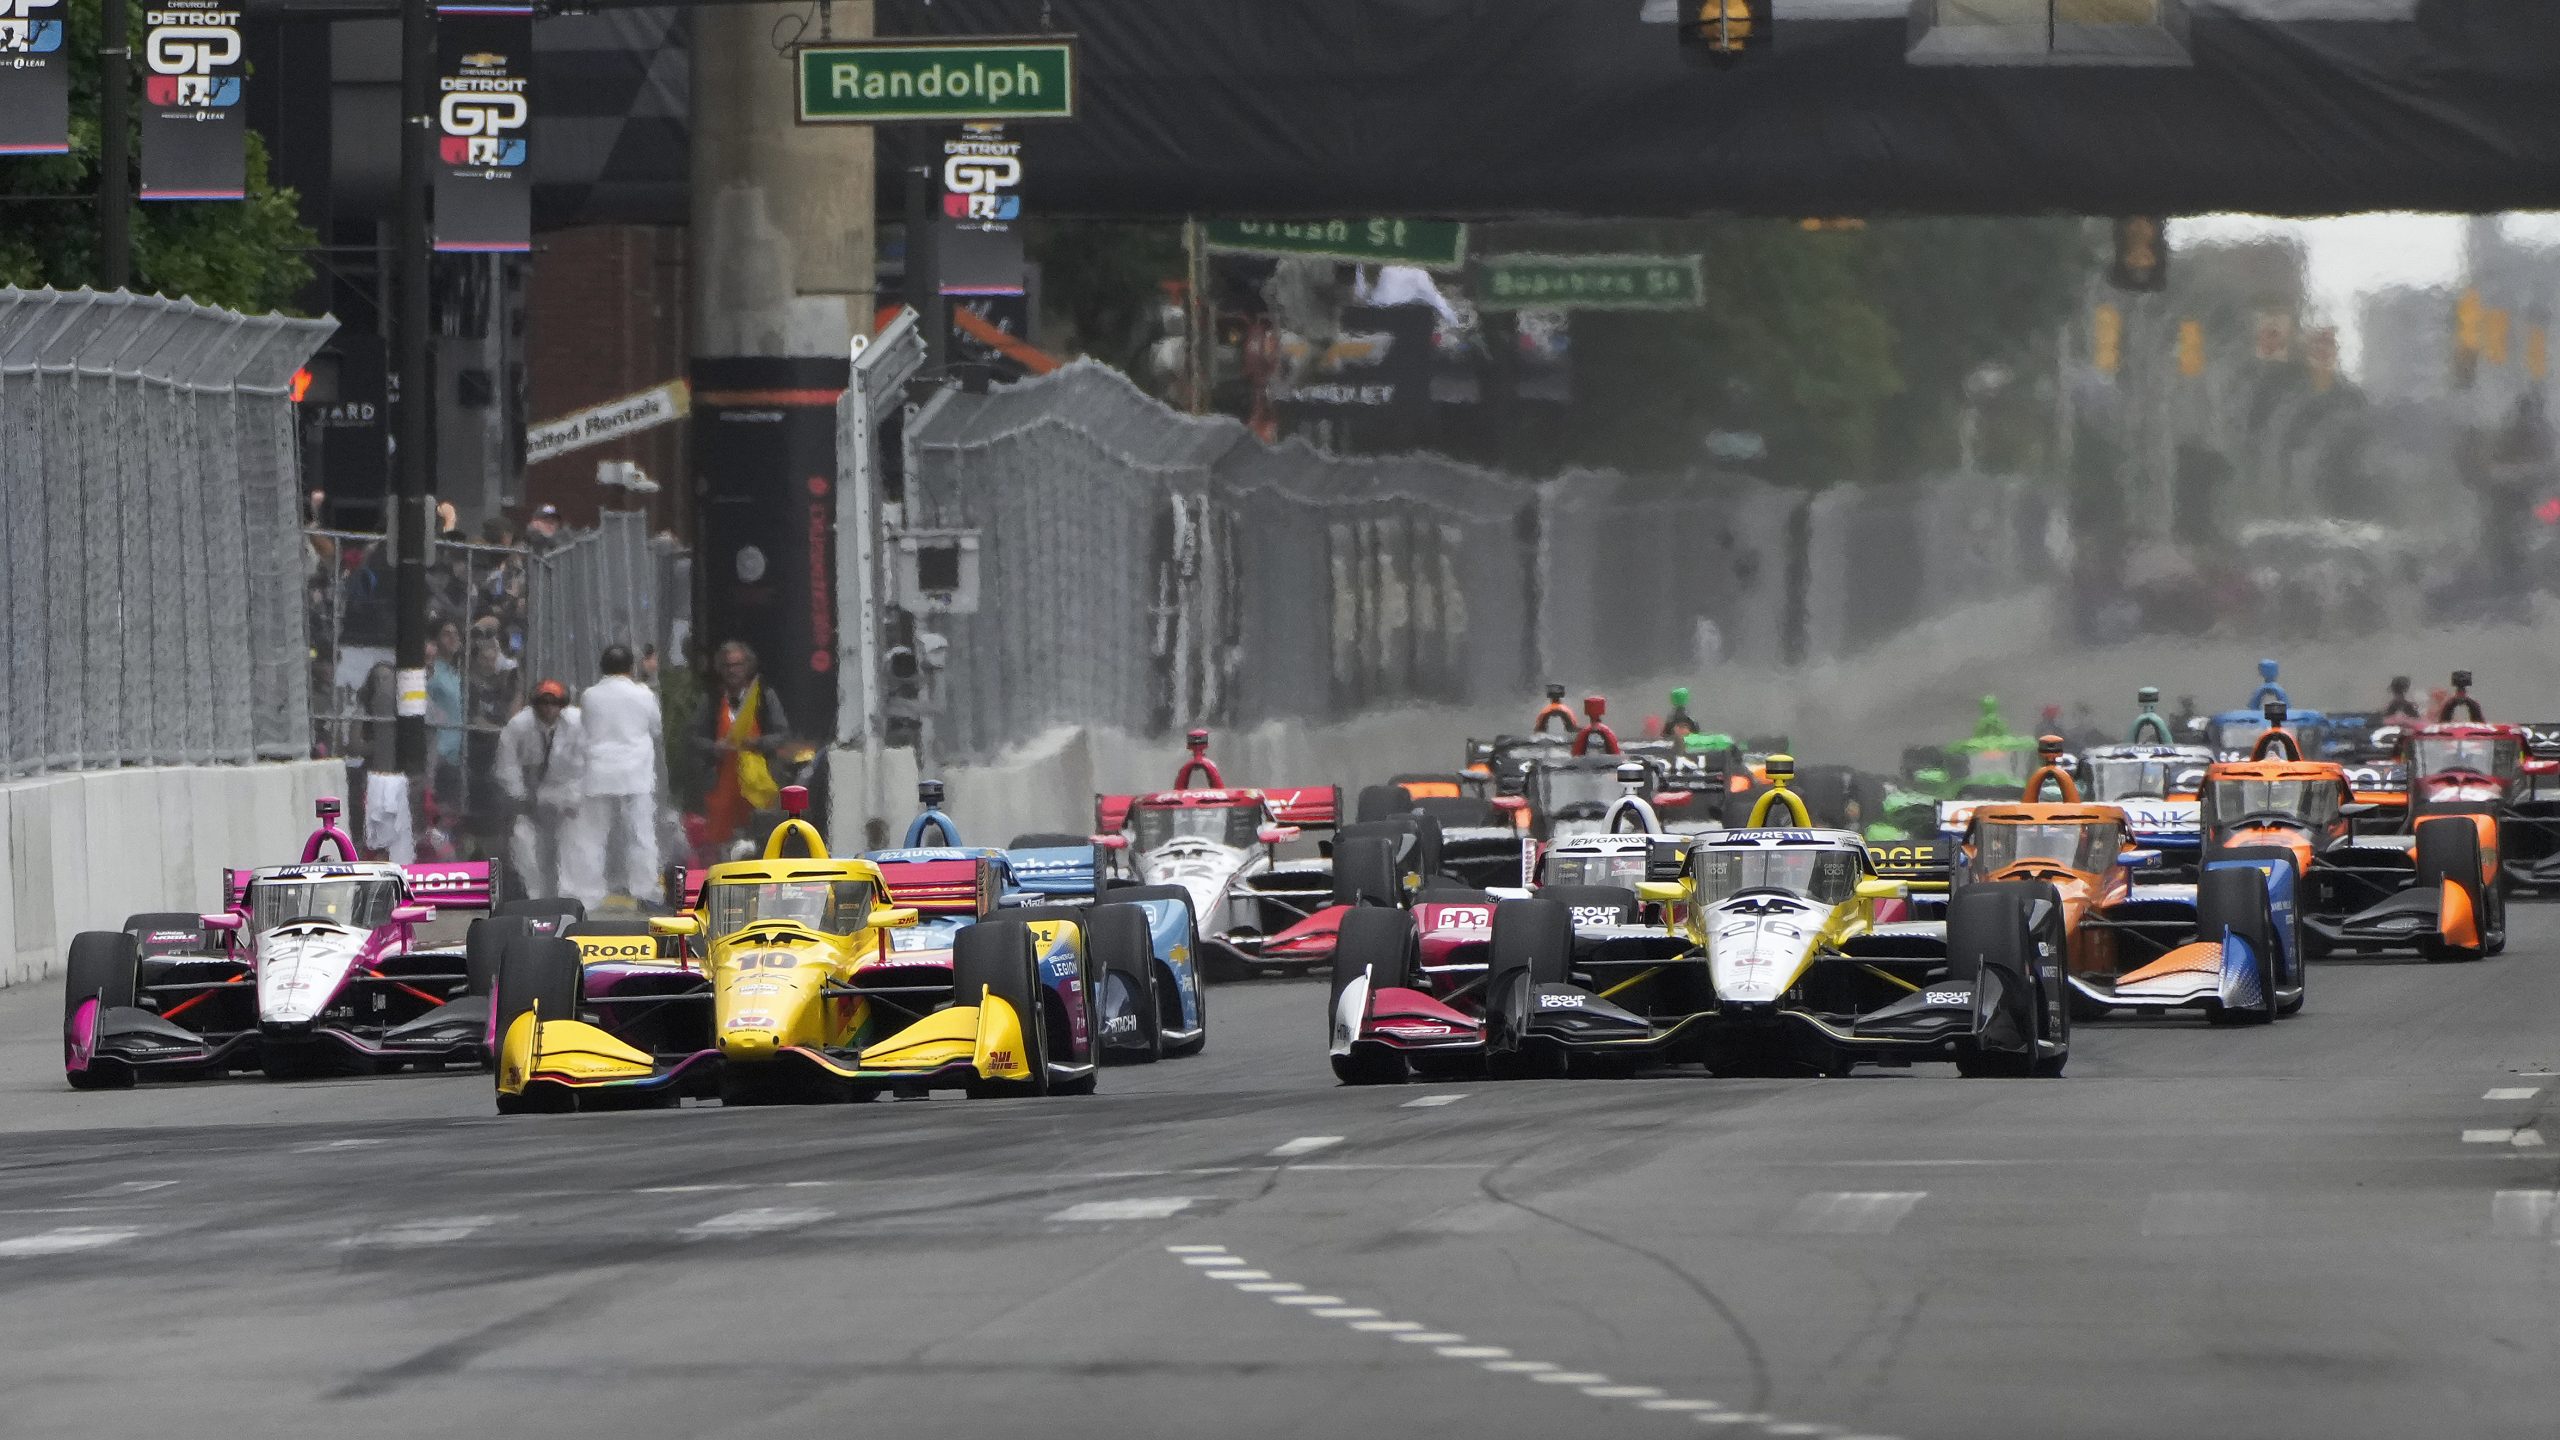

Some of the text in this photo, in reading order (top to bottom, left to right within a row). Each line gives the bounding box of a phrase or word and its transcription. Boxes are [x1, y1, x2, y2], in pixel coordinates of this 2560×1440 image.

[147, 11, 240, 25] DETROIT
[147, 27, 241, 74] GP
[440, 78, 528, 91] DETROIT
[832, 62, 1040, 104] Randolph
[206, 112, 225, 120] LEAR
[440, 92, 528, 136] GP
[944, 143, 1021, 155] DETROIT
[944, 155, 1021, 193] GP
[527, 399, 660, 452] nited Rentals
[1568, 836, 1646, 847] NEWGARDE
[1728, 831, 1811, 842] ANDRETTI
[1867, 846, 1934, 869] DGE
[281, 865, 353, 875] ANDRETTI
[1013, 857, 1080, 877] gher
[402, 867, 471, 891] tion
[1569, 906, 1621, 916] ROUP
[1441, 910, 1487, 930] PPG
[1573, 915, 1616, 925] 001
[583, 943, 651, 957] Root
[737, 951, 799, 971] 10
[1051, 961, 1078, 977] LEGION
[1541, 994, 1586, 1002] GROUP
[1926, 991, 1971, 999] GROUP
[1541, 1000, 1583, 1008] 1001
